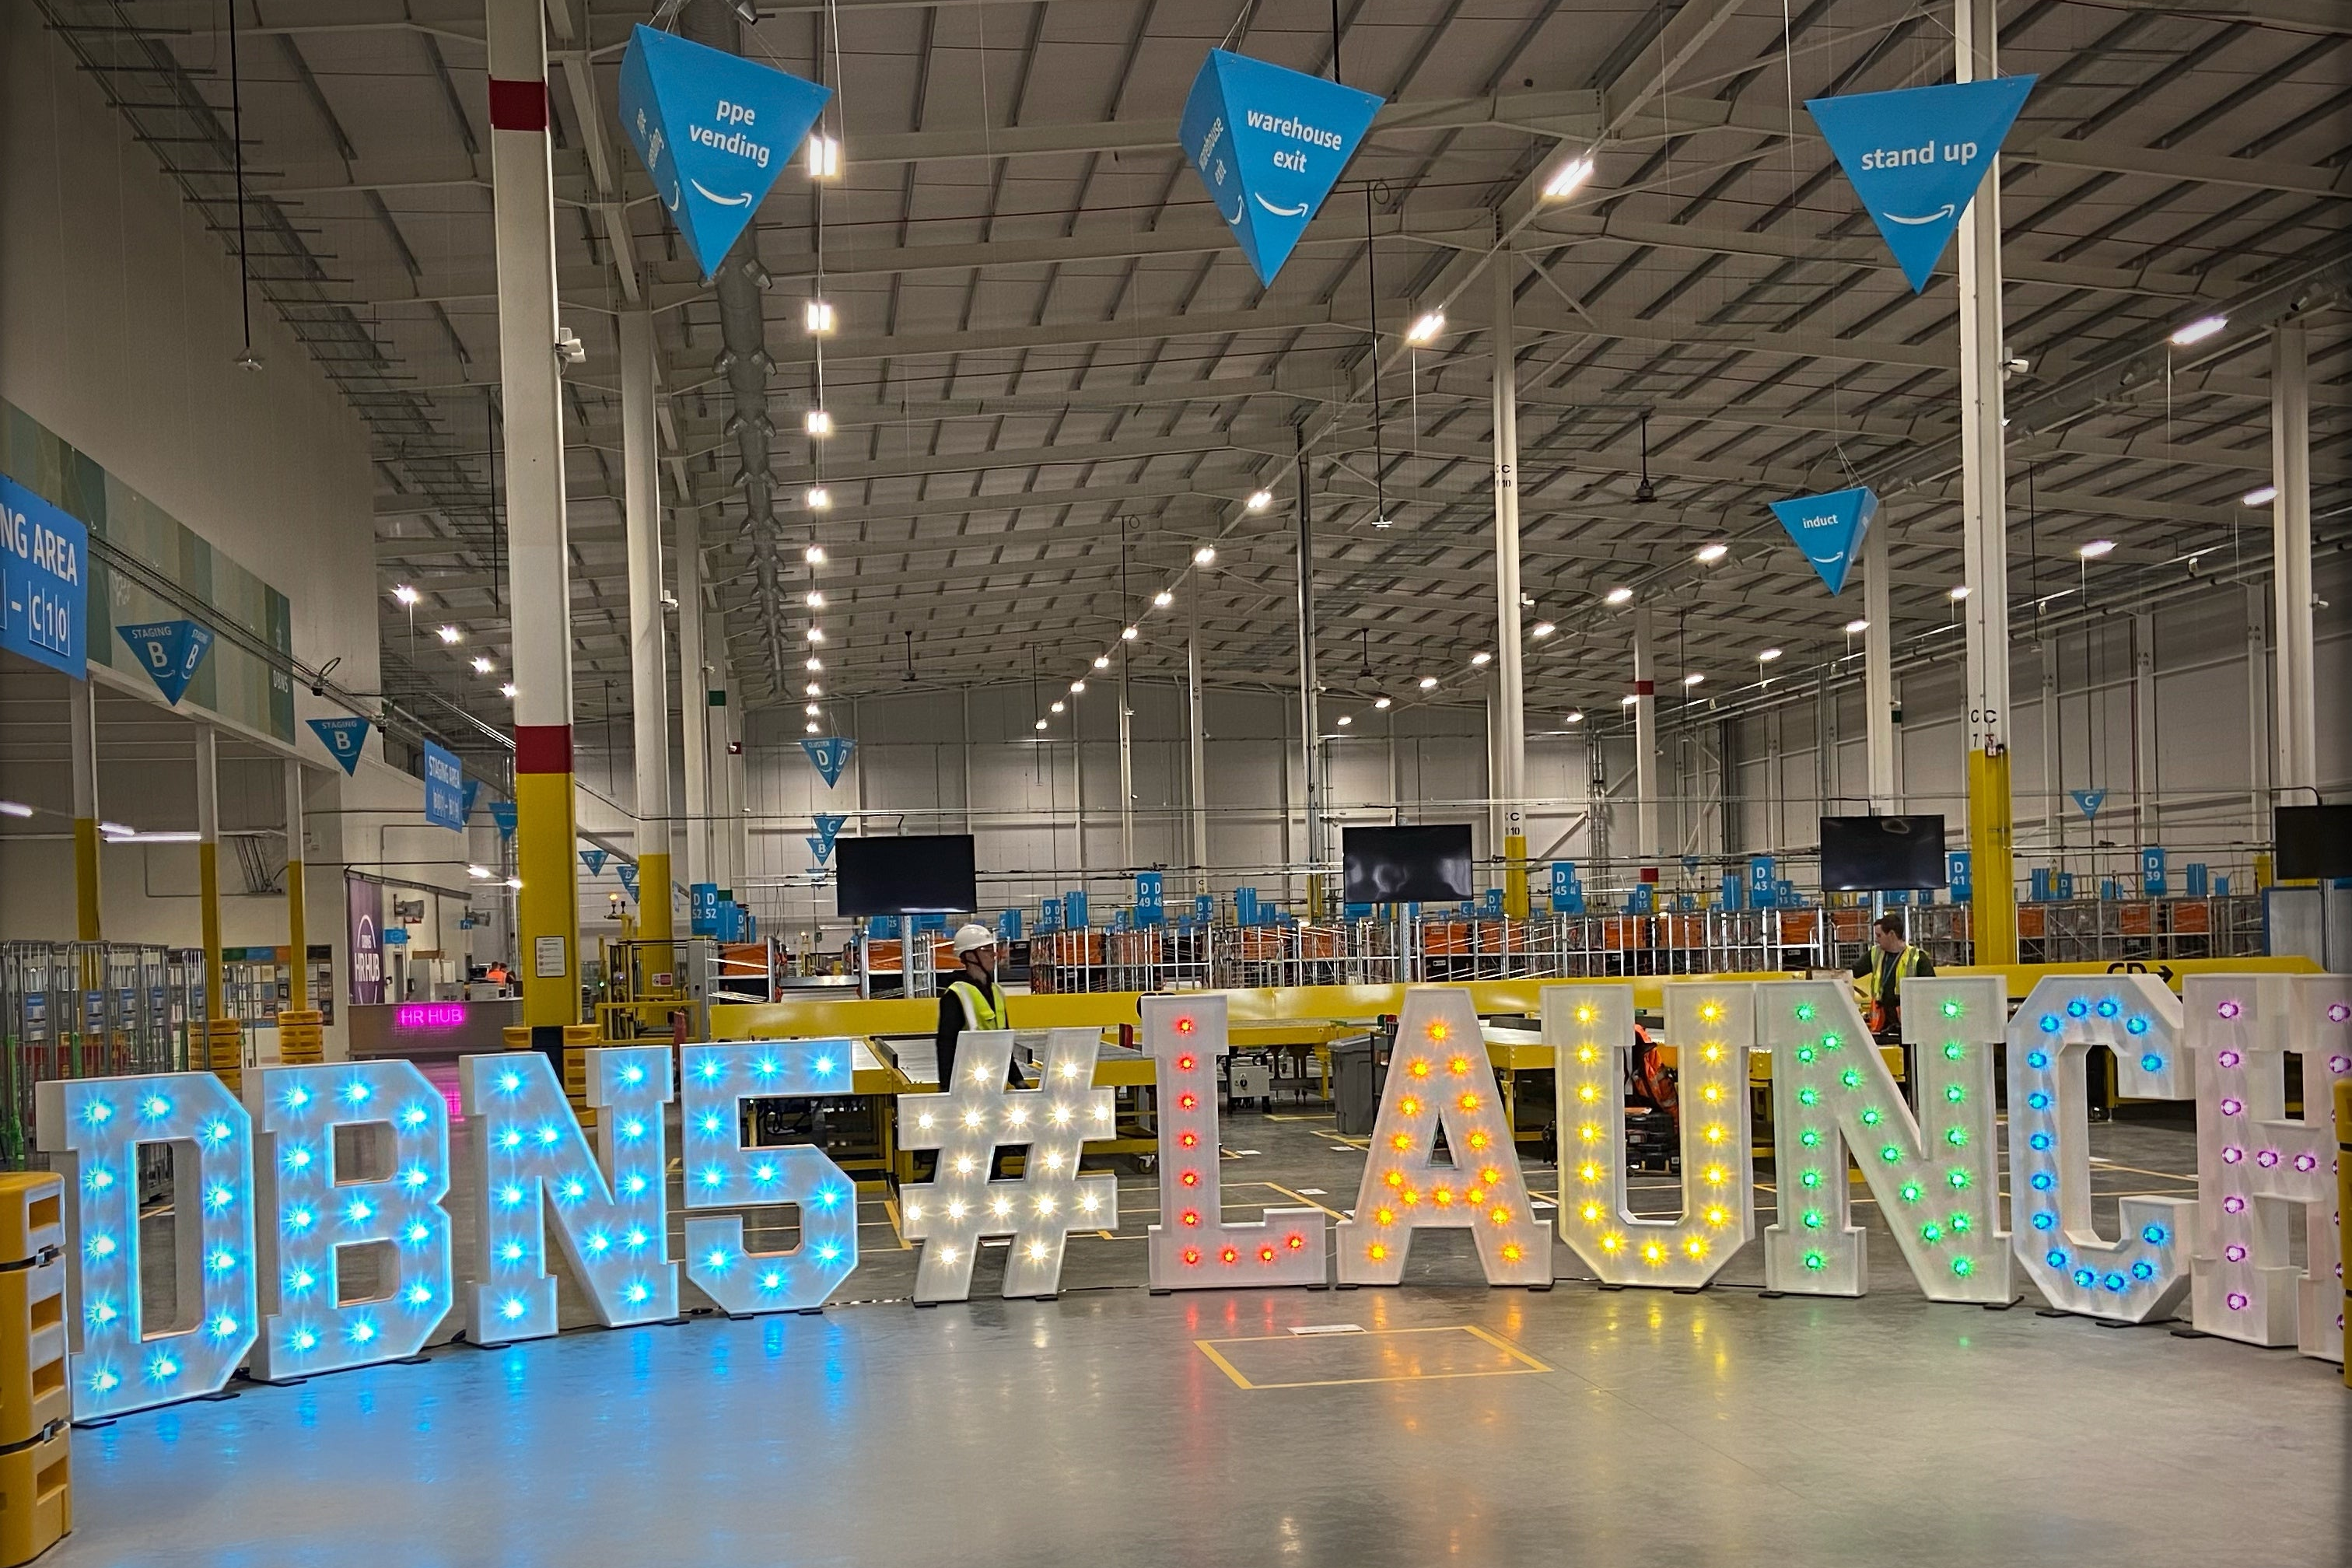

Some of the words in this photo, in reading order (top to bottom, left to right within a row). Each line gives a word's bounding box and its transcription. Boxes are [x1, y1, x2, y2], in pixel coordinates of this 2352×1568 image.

[716, 100, 755, 125] ppe
[1247, 110, 1342, 151] warehouse
[689, 124, 770, 168] vending
[1273, 150, 1307, 173] exit
[1861, 141, 1934, 170] stand
[1944, 142, 1978, 166] up
[1501, 464, 1510, 474] C
[1502, 479, 1511, 488] 10
[1801, 513, 1839, 529] induct
[33, 523, 79, 586] AREA
[131, 626, 173, 639] STAGING
[147, 642, 168, 668] B
[186, 644, 198, 670] B
[1971, 709, 1979, 723] C
[1984, 709, 1997, 723] C
[321, 720, 358, 730] STAGING
[334, 731, 351, 750] B
[1973, 733, 1978, 747] 7
[817, 750, 829, 766] D
[2084, 796, 2094, 807] C
[1510, 812, 1520, 821] C
[828, 821, 836, 833] C
[1510, 827, 1520, 835] 10
[818, 843, 827, 853] B
[1954, 861, 1964, 873] D
[2148, 857, 2158, 869] D
[1556, 871, 1566, 884] D
[1756, 866, 1766, 879] D
[2146, 871, 2161, 881] 39
[1754, 880, 1768, 891] 43
[1951, 876, 1965, 885] 41
[1140, 882, 1149, 895] D
[1154, 882, 1161, 894] D
[1554, 885, 1567, 896] 45
[1780, 887, 1787, 895] D
[693, 893, 700, 906] D
[706, 893, 715, 905] D
[1489, 894, 1495, 905] D
[1639, 890, 1647, 900] D
[1139, 897, 1151, 908] 49
[1198, 902, 1203, 912] D
[692, 908, 702, 919] 52
[705, 908, 716, 919] 52
[1045, 905, 1052, 915] D
[1055, 905, 1060, 915] D
[738, 915, 744, 924] D
[401, 1010, 424, 1024] HR
[428, 1009, 463, 1023] HUB
